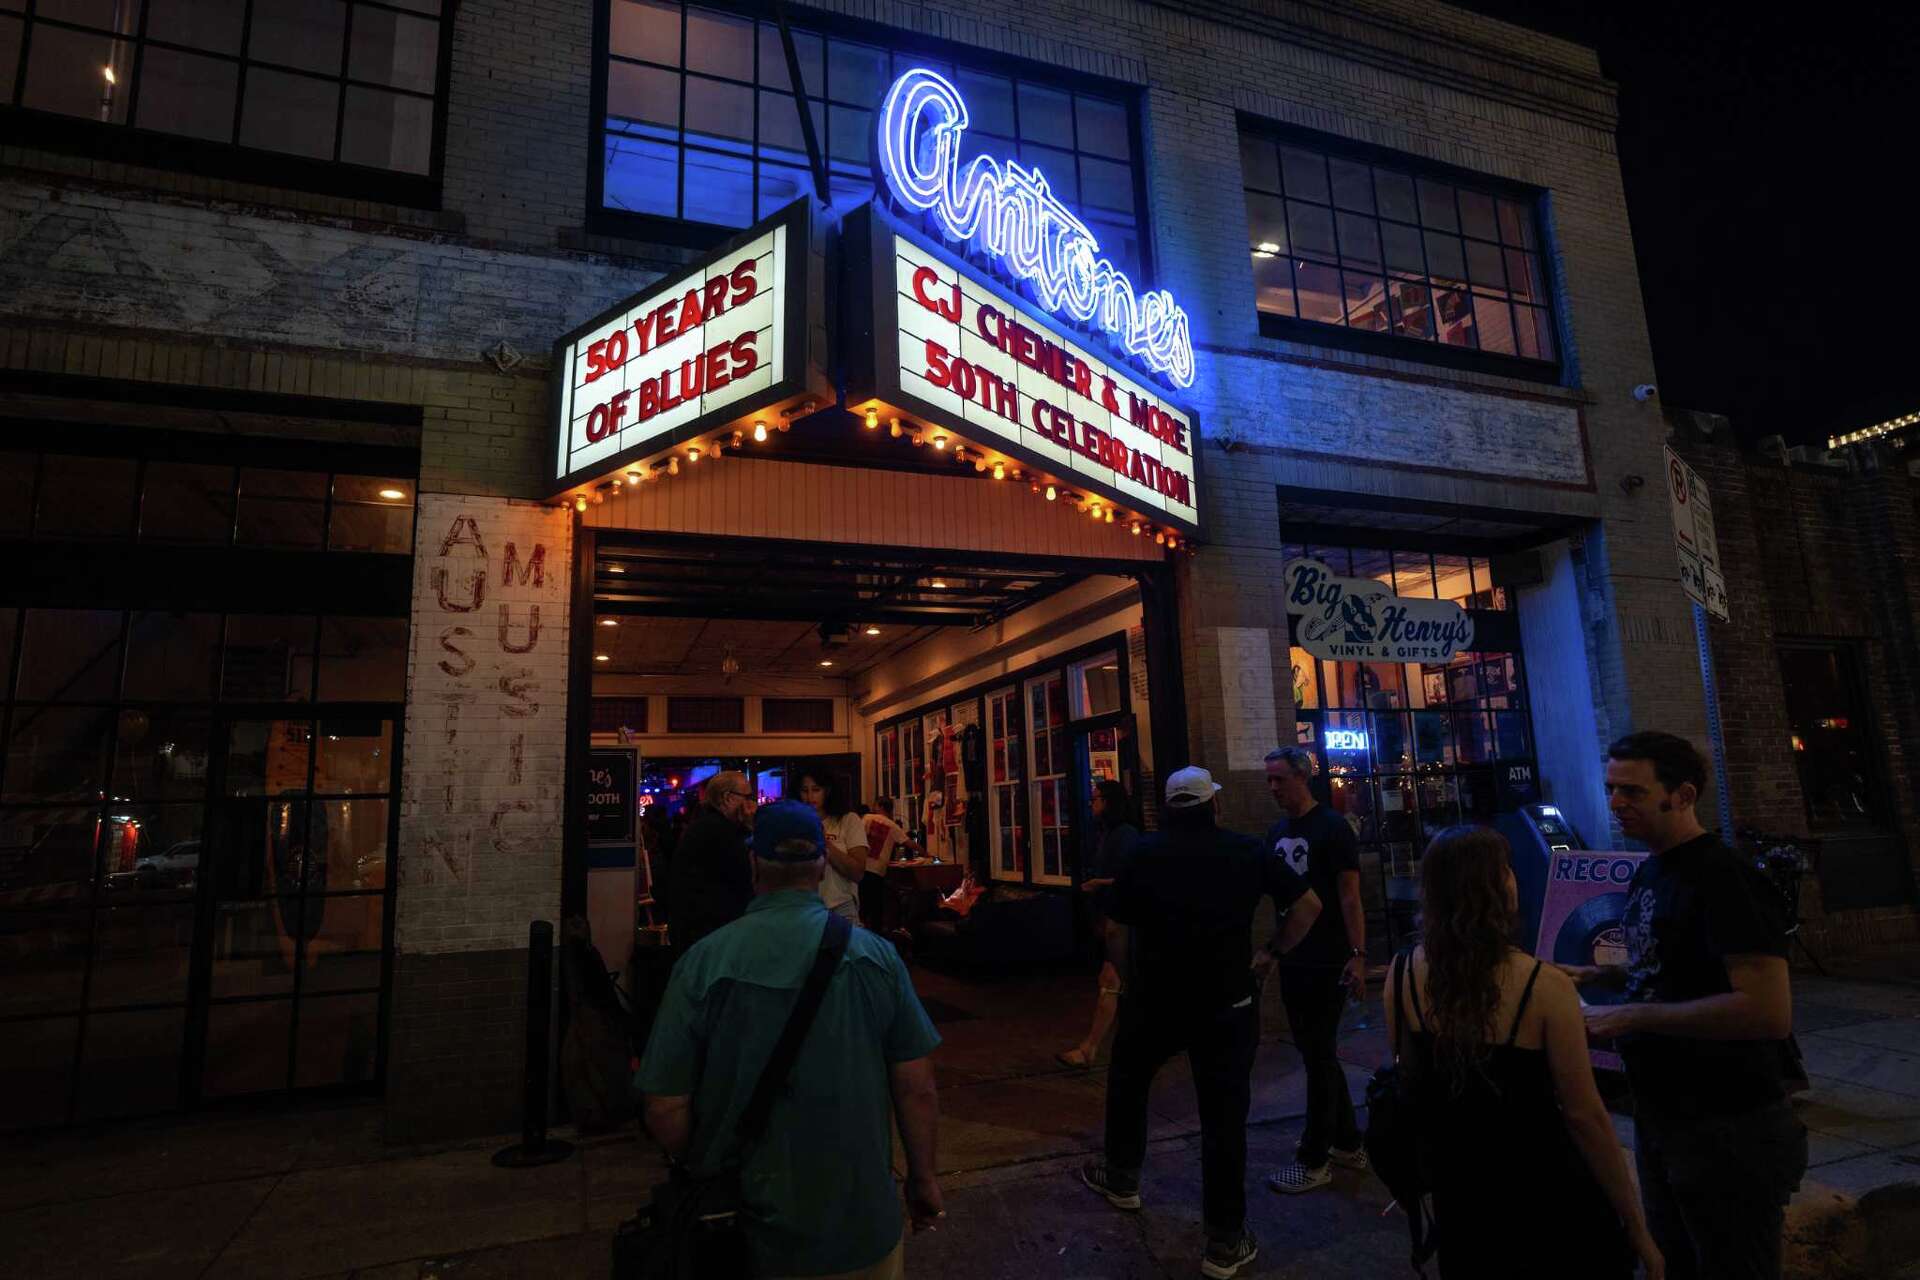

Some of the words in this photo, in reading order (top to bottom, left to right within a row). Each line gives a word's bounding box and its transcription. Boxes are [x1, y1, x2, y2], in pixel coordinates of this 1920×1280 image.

[585, 330, 629, 384] 50
[634, 259, 757, 356] YEARS
[913, 266, 962, 323] CJ
[977, 304, 1092, 400] CHENIER
[1101, 375, 1120, 416] &
[1129, 391, 1189, 455] MORE
[586, 389, 631, 443] OF
[638, 331, 758, 423] BLUES
[925, 339, 1018, 424] 50TH
[1032, 399, 1190, 507] CELEBRATION
[1291, 565, 1341, 620] Big
[1377, 606, 1471, 657] Henry's
[1330, 644, 1374, 656] VINYL
[1382, 646, 1390, 657] &
[1399, 647, 1438, 658] GIFTS
[489, 542, 549, 854] MUSIC
[1324, 731, 1365, 750] OPEN
[1508, 766, 1532, 780] ATM
